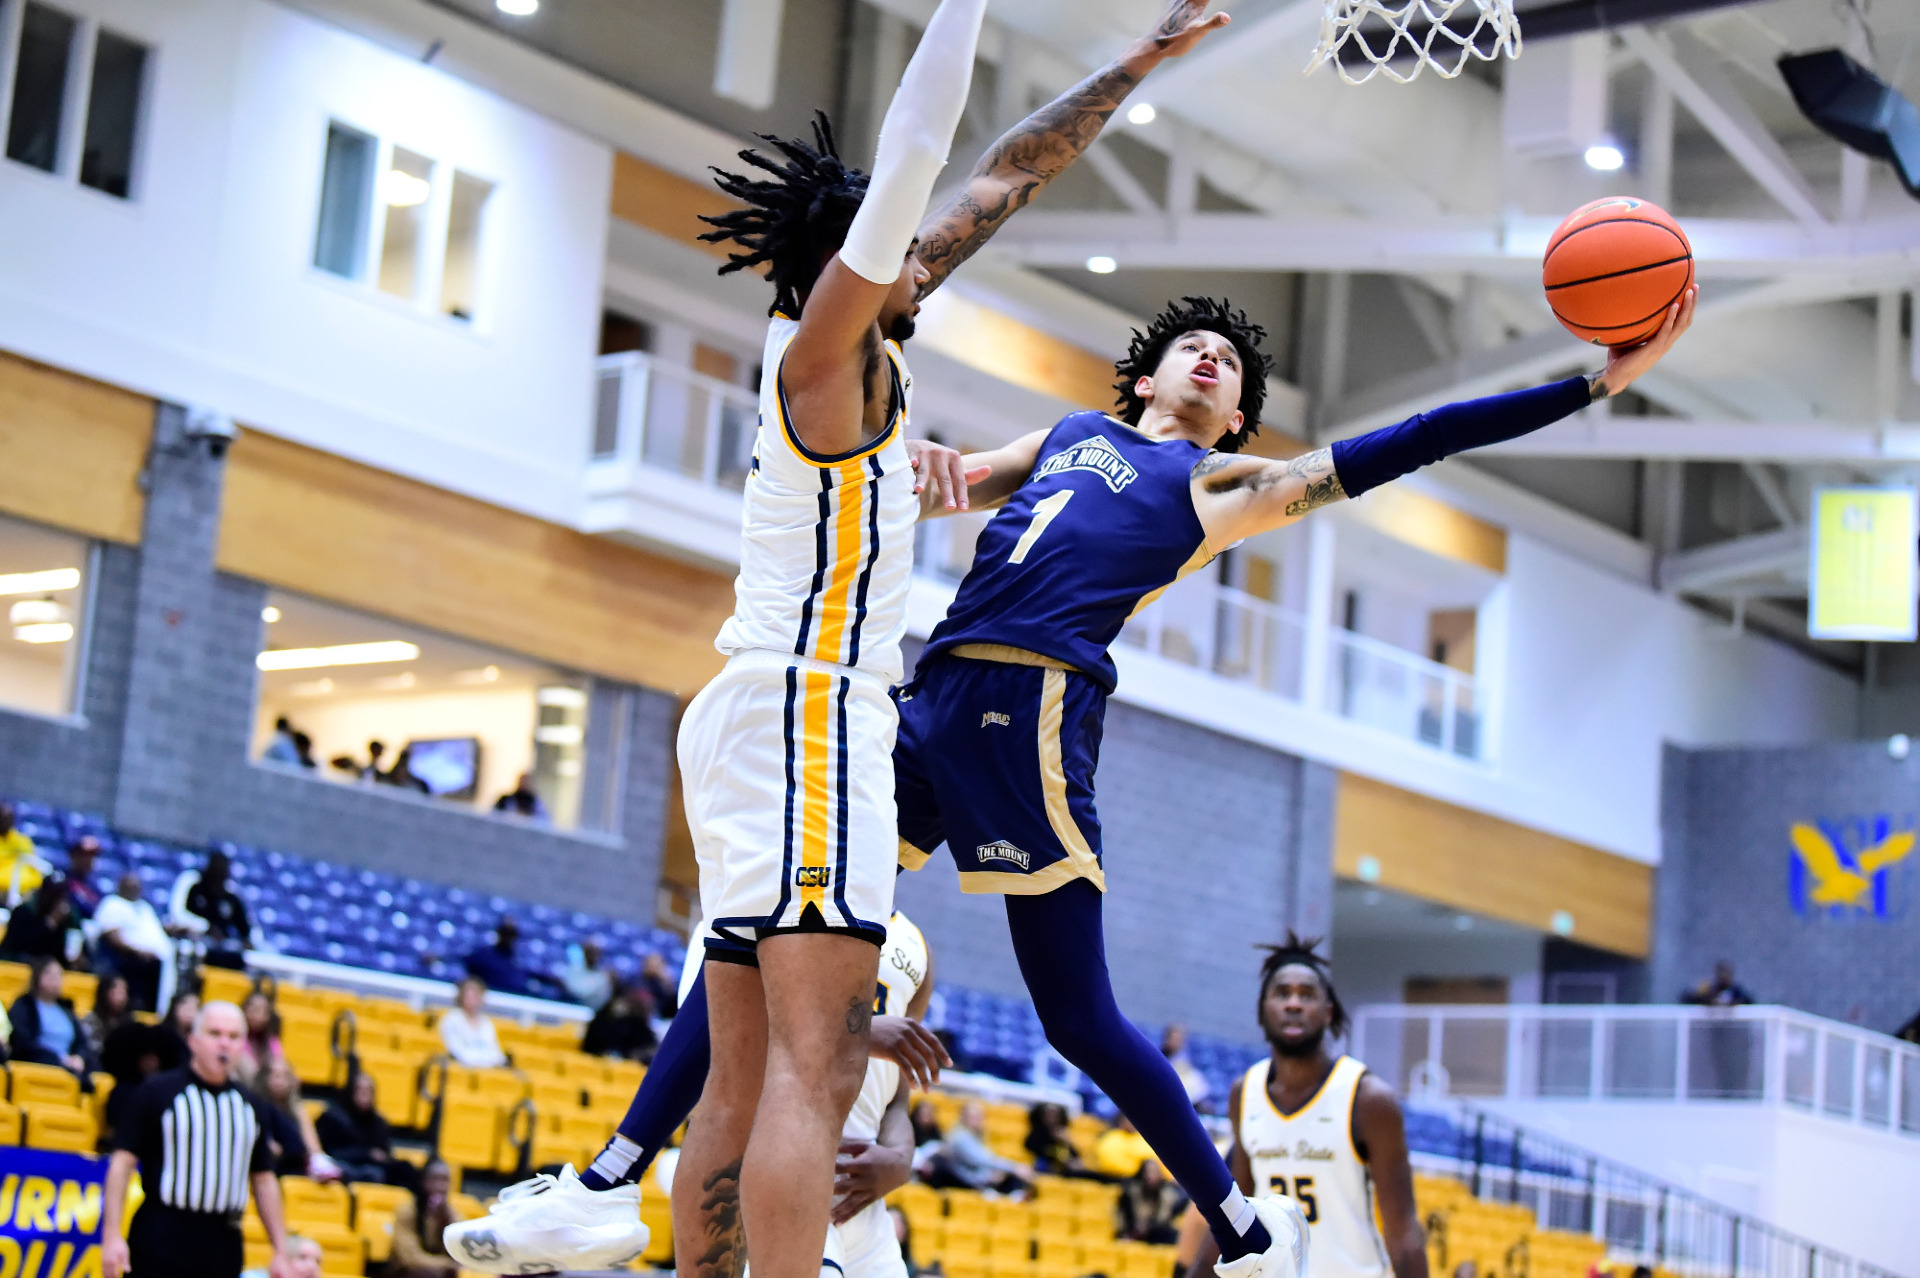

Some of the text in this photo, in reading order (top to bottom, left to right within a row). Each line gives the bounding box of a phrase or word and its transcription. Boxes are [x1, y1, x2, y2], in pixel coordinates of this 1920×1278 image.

[1041, 448, 1134, 486] THE MOUNT
[1007, 489, 1075, 564] 1
[979, 847, 1028, 866] THE MOUNT
[795, 866, 832, 888] CSU
